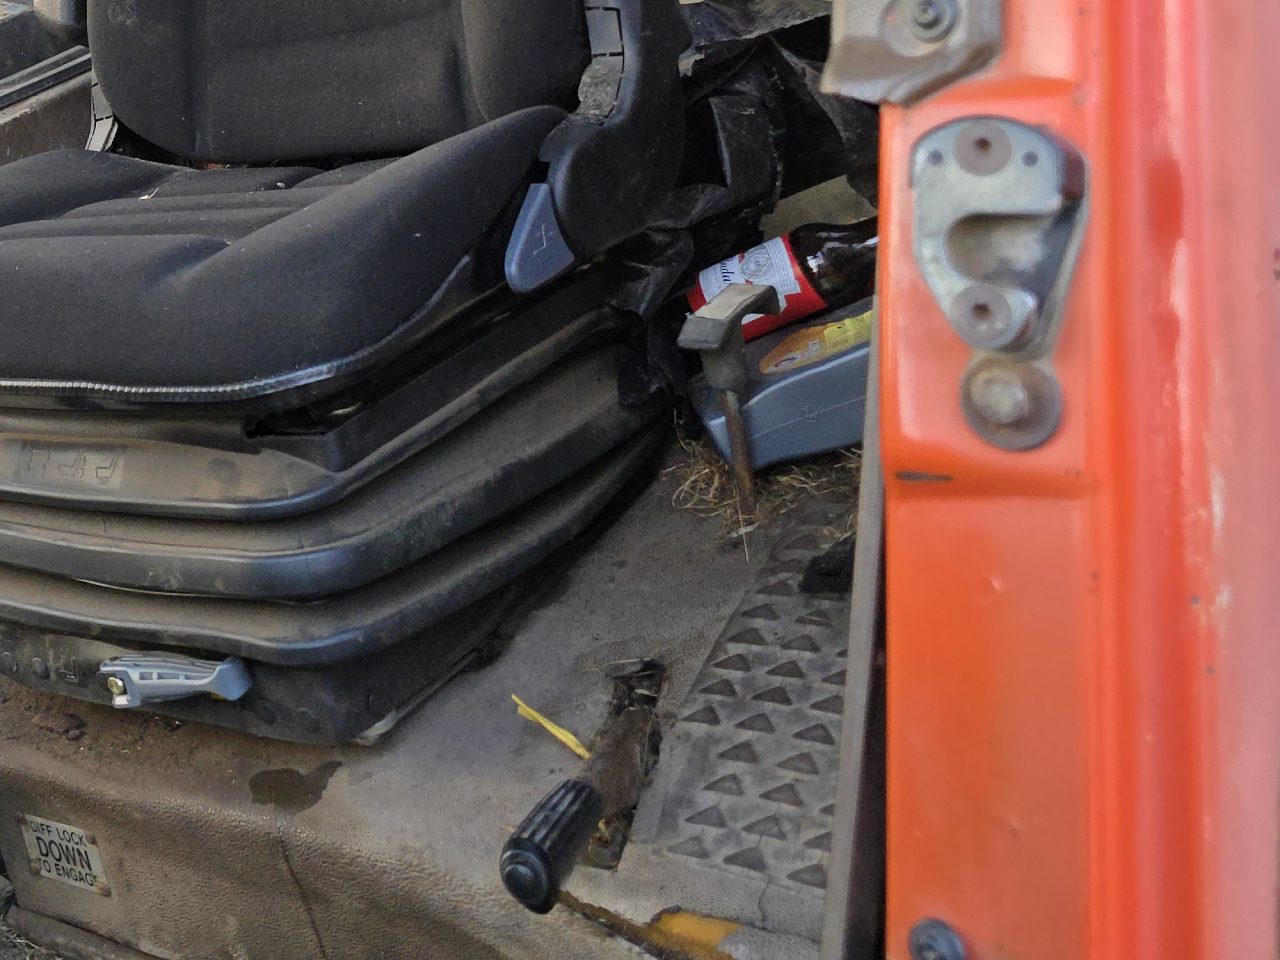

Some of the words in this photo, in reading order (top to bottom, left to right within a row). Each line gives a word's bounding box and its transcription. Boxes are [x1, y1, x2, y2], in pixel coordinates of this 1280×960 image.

[29, 820, 52, 837] DIFF
[56, 827, 87, 847] LOCK
[35, 858, 51, 873] TO
[36, 836, 93, 871] DOWN
